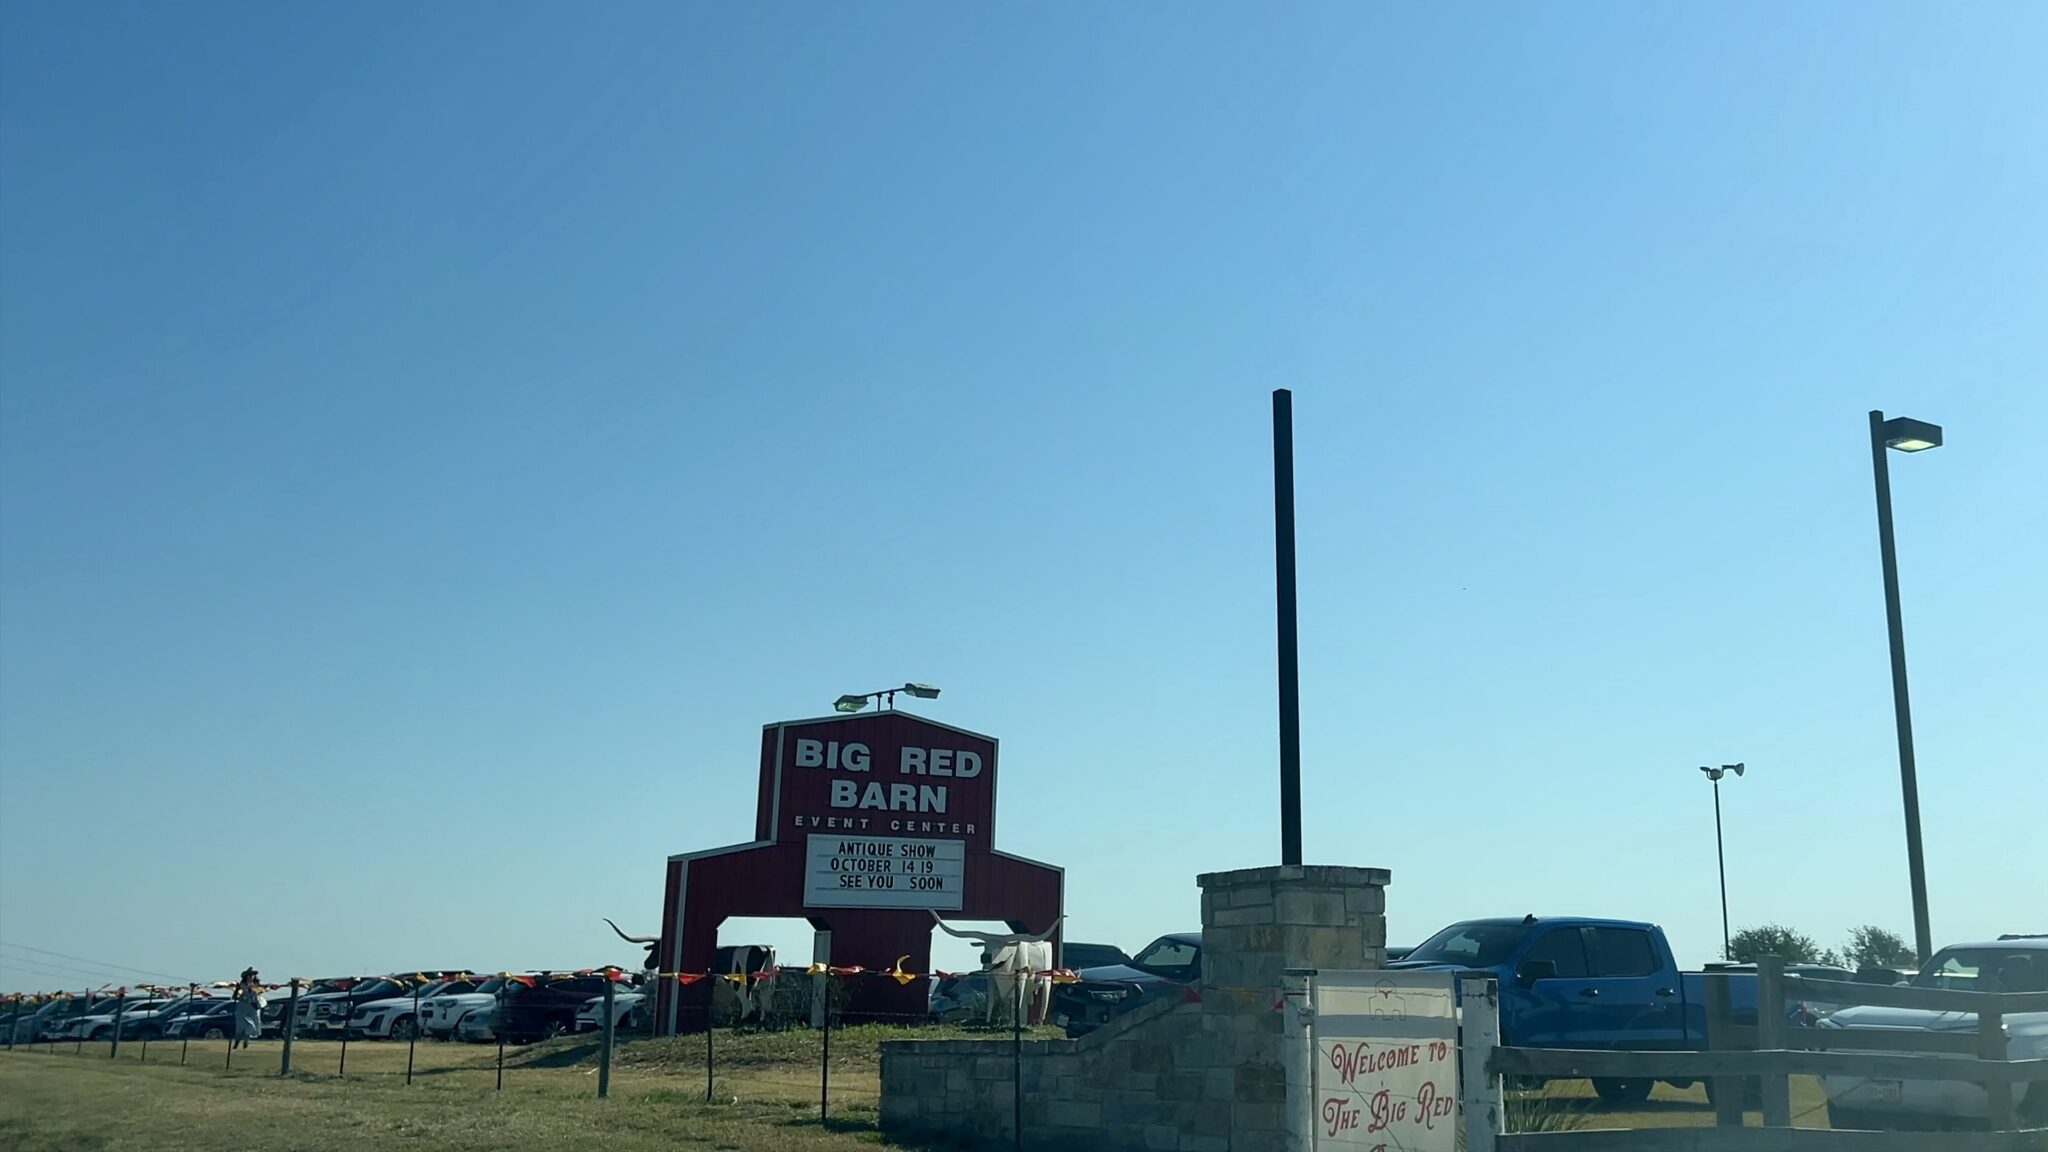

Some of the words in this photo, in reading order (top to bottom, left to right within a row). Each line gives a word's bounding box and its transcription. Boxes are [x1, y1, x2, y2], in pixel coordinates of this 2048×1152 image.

[795, 739, 870, 772] BIG
[900, 747, 982, 778] RED
[831, 779, 947, 813] BARN
[795, 816, 869, 829] EVENT
[891, 821, 975, 834] CENTER
[838, 842, 893, 856] ANTIQUE
[901, 844, 935, 857] SHOW
[831, 859, 891, 872] OCTOBER
[902, 861, 914, 873] 14
[921, 861, 933, 873] 19
[840, 875, 861, 887] SEE
[868, 876, 893, 888] YOU
[910, 877, 943, 889] SOON
[1332, 1042, 1420, 1084] WELCOME
[1429, 1042, 1447, 1062] TO
[1323, 1098, 1360, 1137] THE
[1368, 1089, 1406, 1133] BIG
[1415, 1081, 1452, 1130] RED
